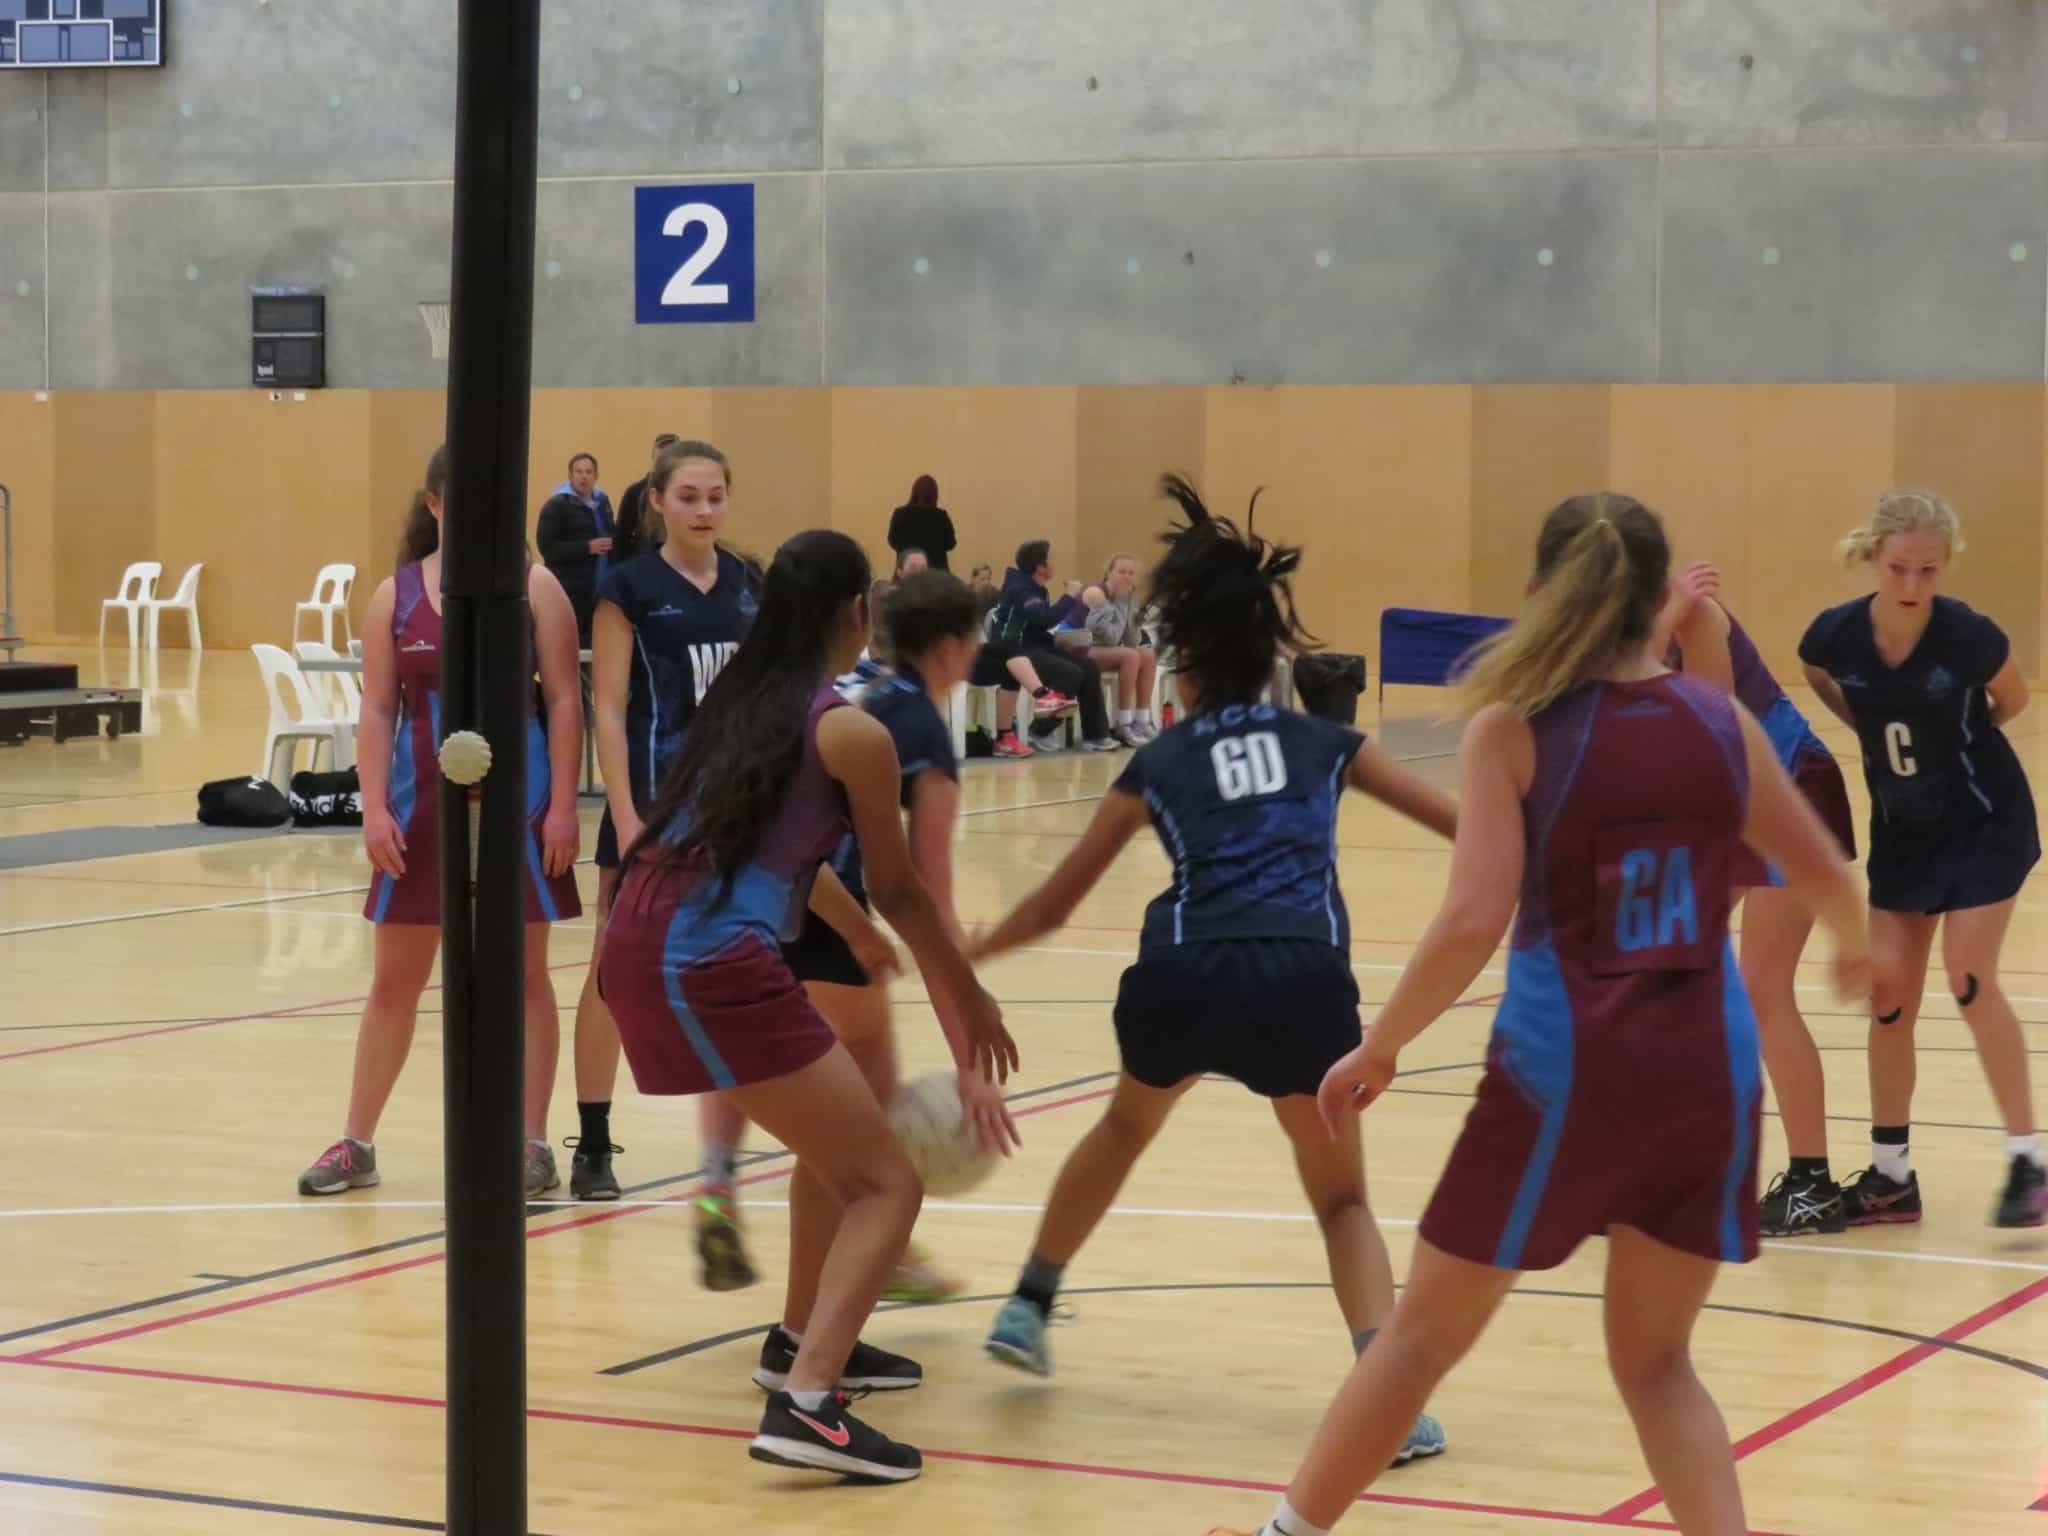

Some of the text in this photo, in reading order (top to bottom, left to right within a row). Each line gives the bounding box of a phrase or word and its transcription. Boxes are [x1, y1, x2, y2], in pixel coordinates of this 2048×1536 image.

[661, 202, 729, 305] 2
[1885, 721, 1918, 777] C
[1616, 847, 1697, 951] GA
